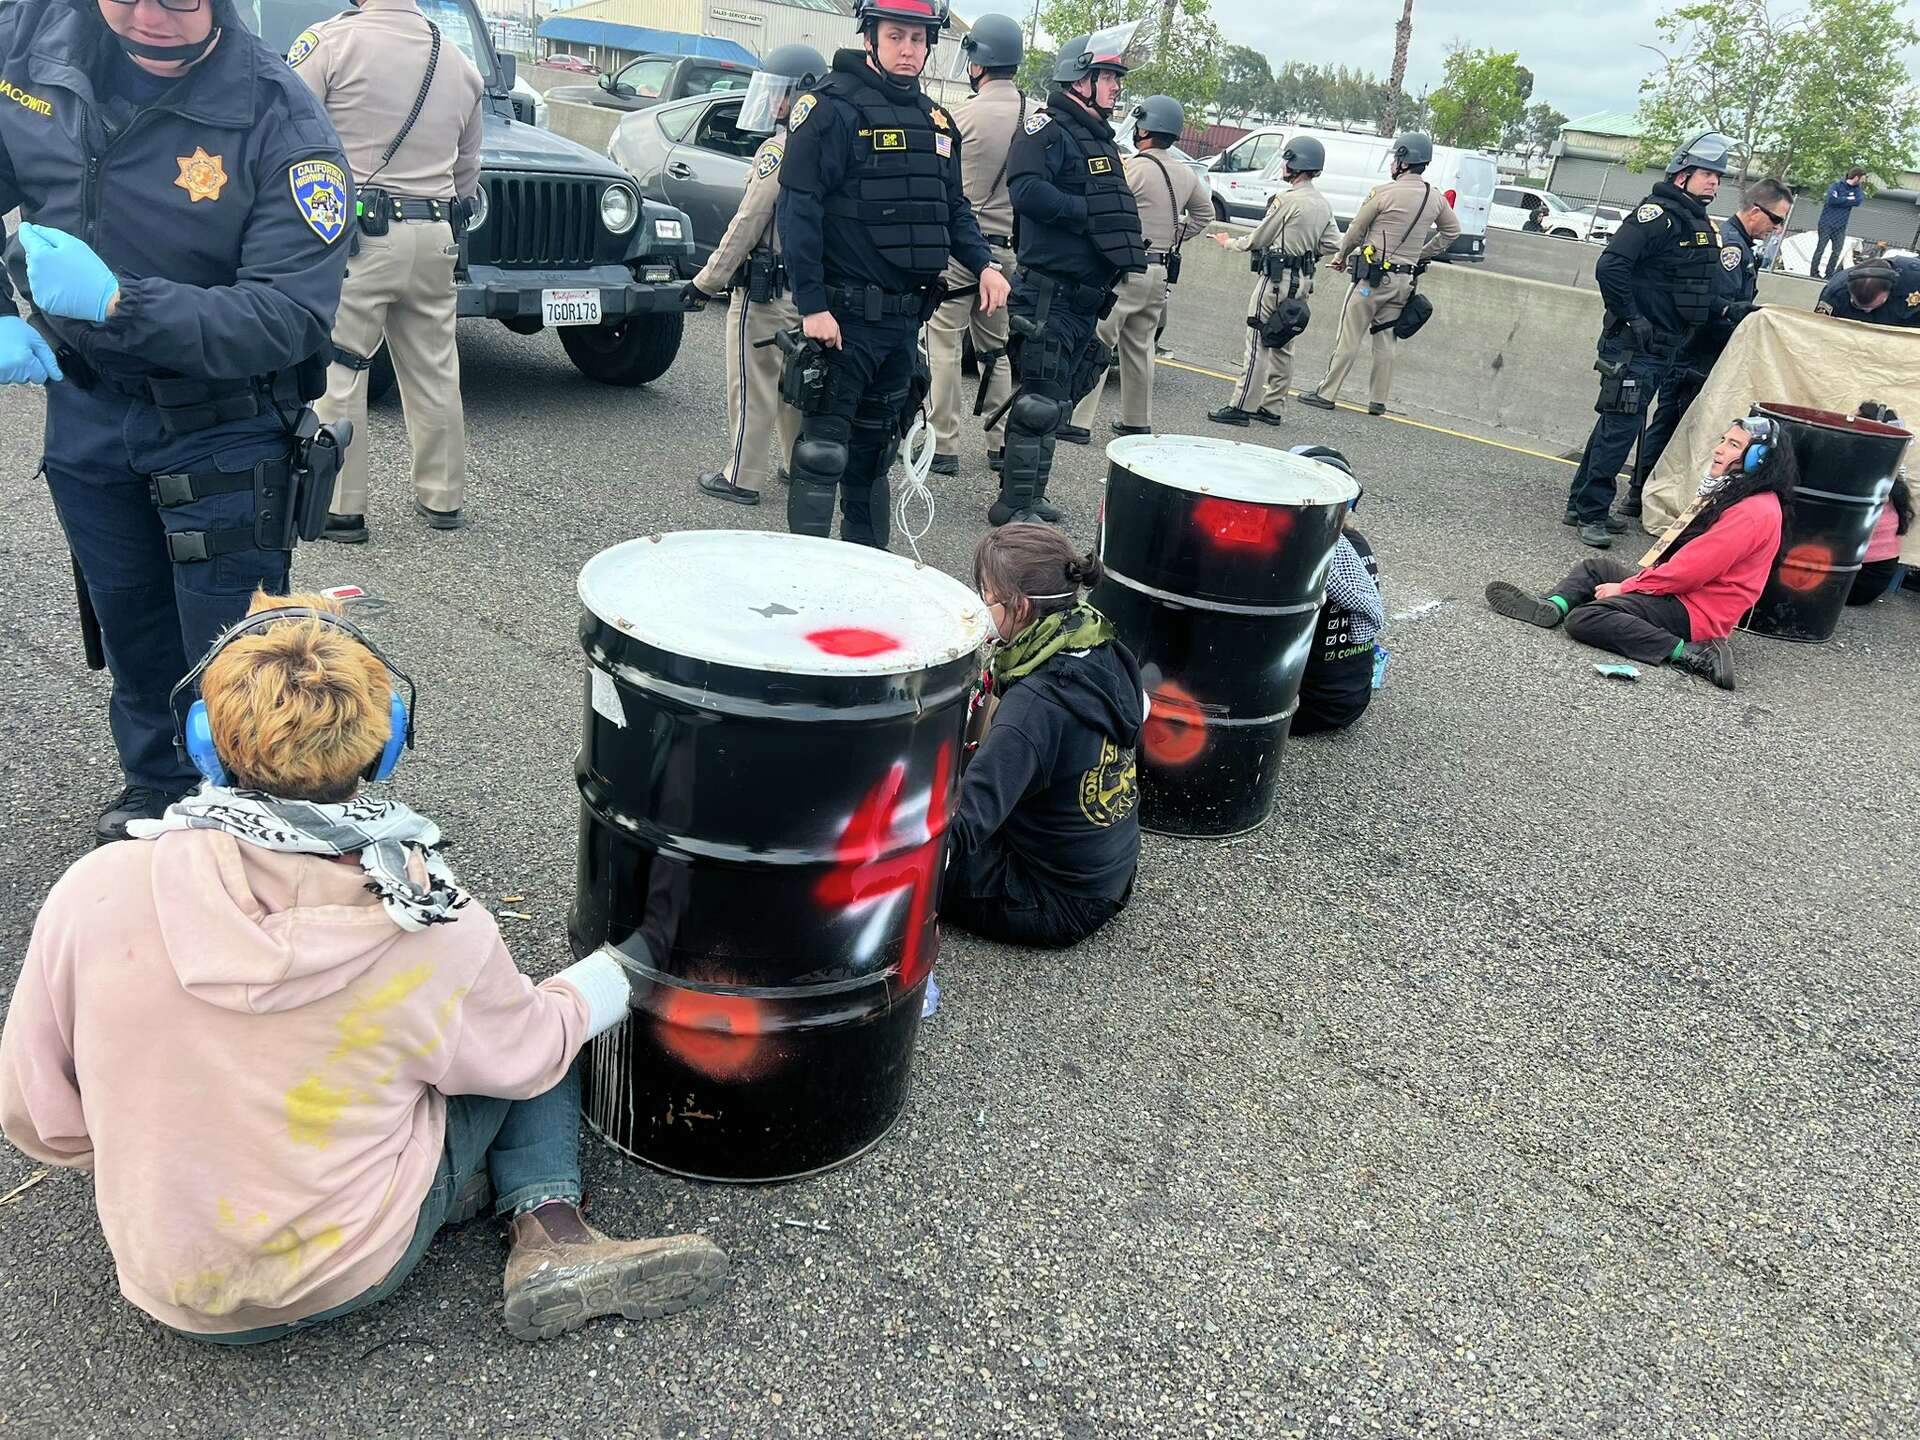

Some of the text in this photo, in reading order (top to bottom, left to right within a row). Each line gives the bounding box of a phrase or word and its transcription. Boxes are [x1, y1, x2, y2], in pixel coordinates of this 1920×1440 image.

[295, 172, 325, 189] HIGHWAY
[297, 164, 343, 182] CALIFORNIA
[546, 302, 598, 321] 7GOR178
